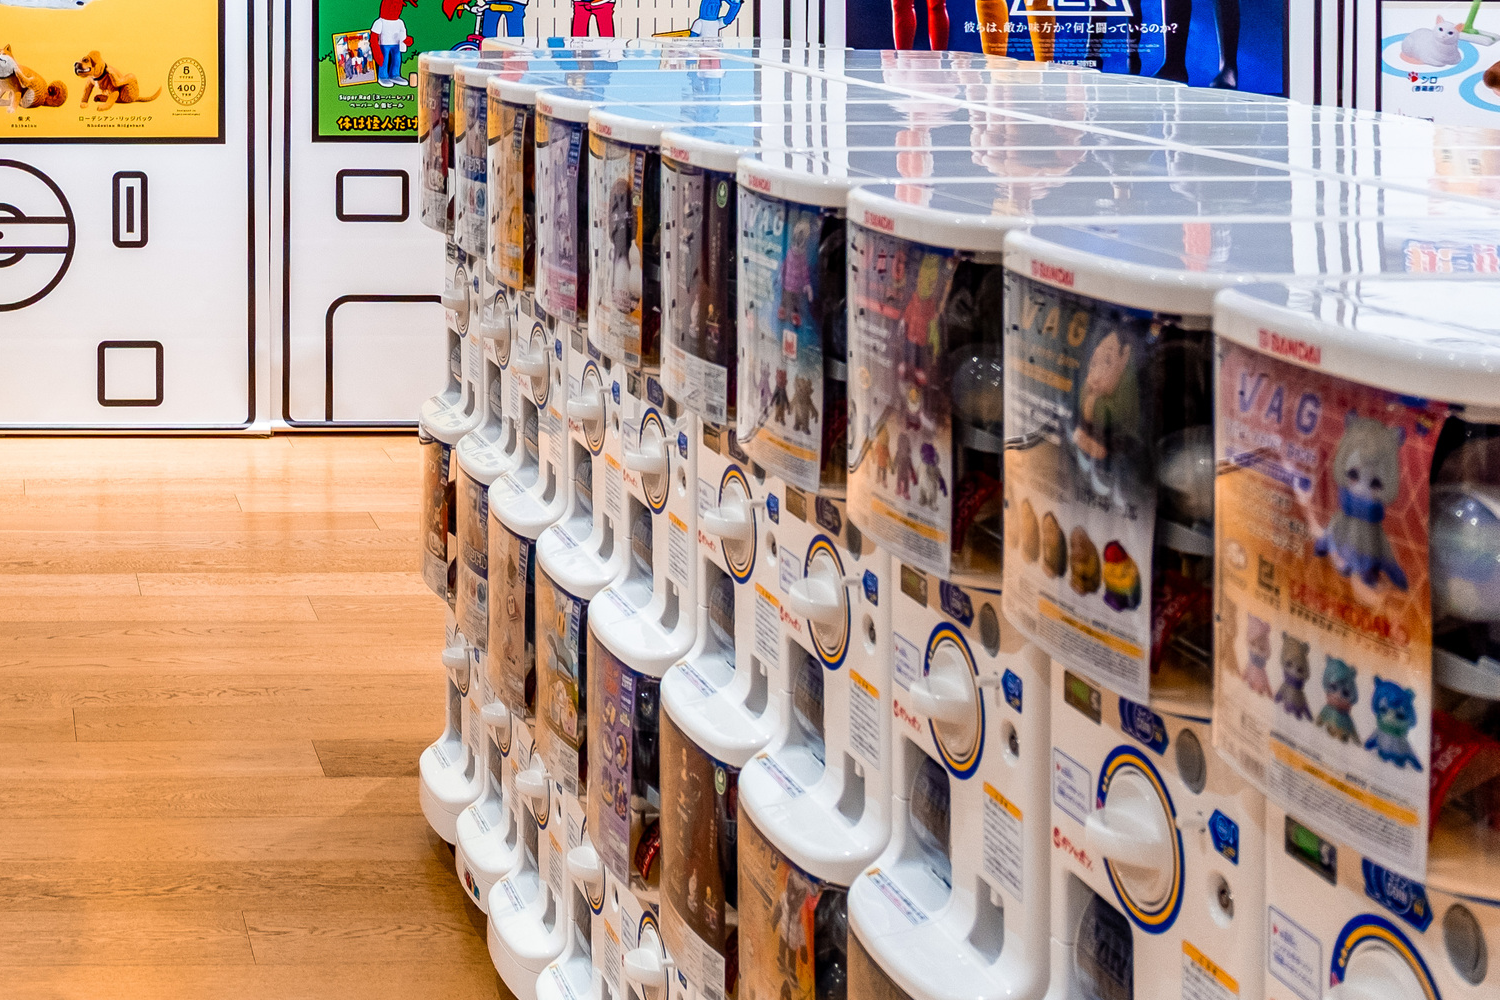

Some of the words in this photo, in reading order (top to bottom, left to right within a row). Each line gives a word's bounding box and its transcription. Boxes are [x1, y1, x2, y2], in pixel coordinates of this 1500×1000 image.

[964, 21, 1179, 35] 彼らは、敵か味方か？何と闘っているのか？
[1420, 76, 1438, 85] シロ
[176, 84, 196, 92] 400
[1021, 294, 1090, 348] VAG
[1238, 371, 1323, 436] VAG
